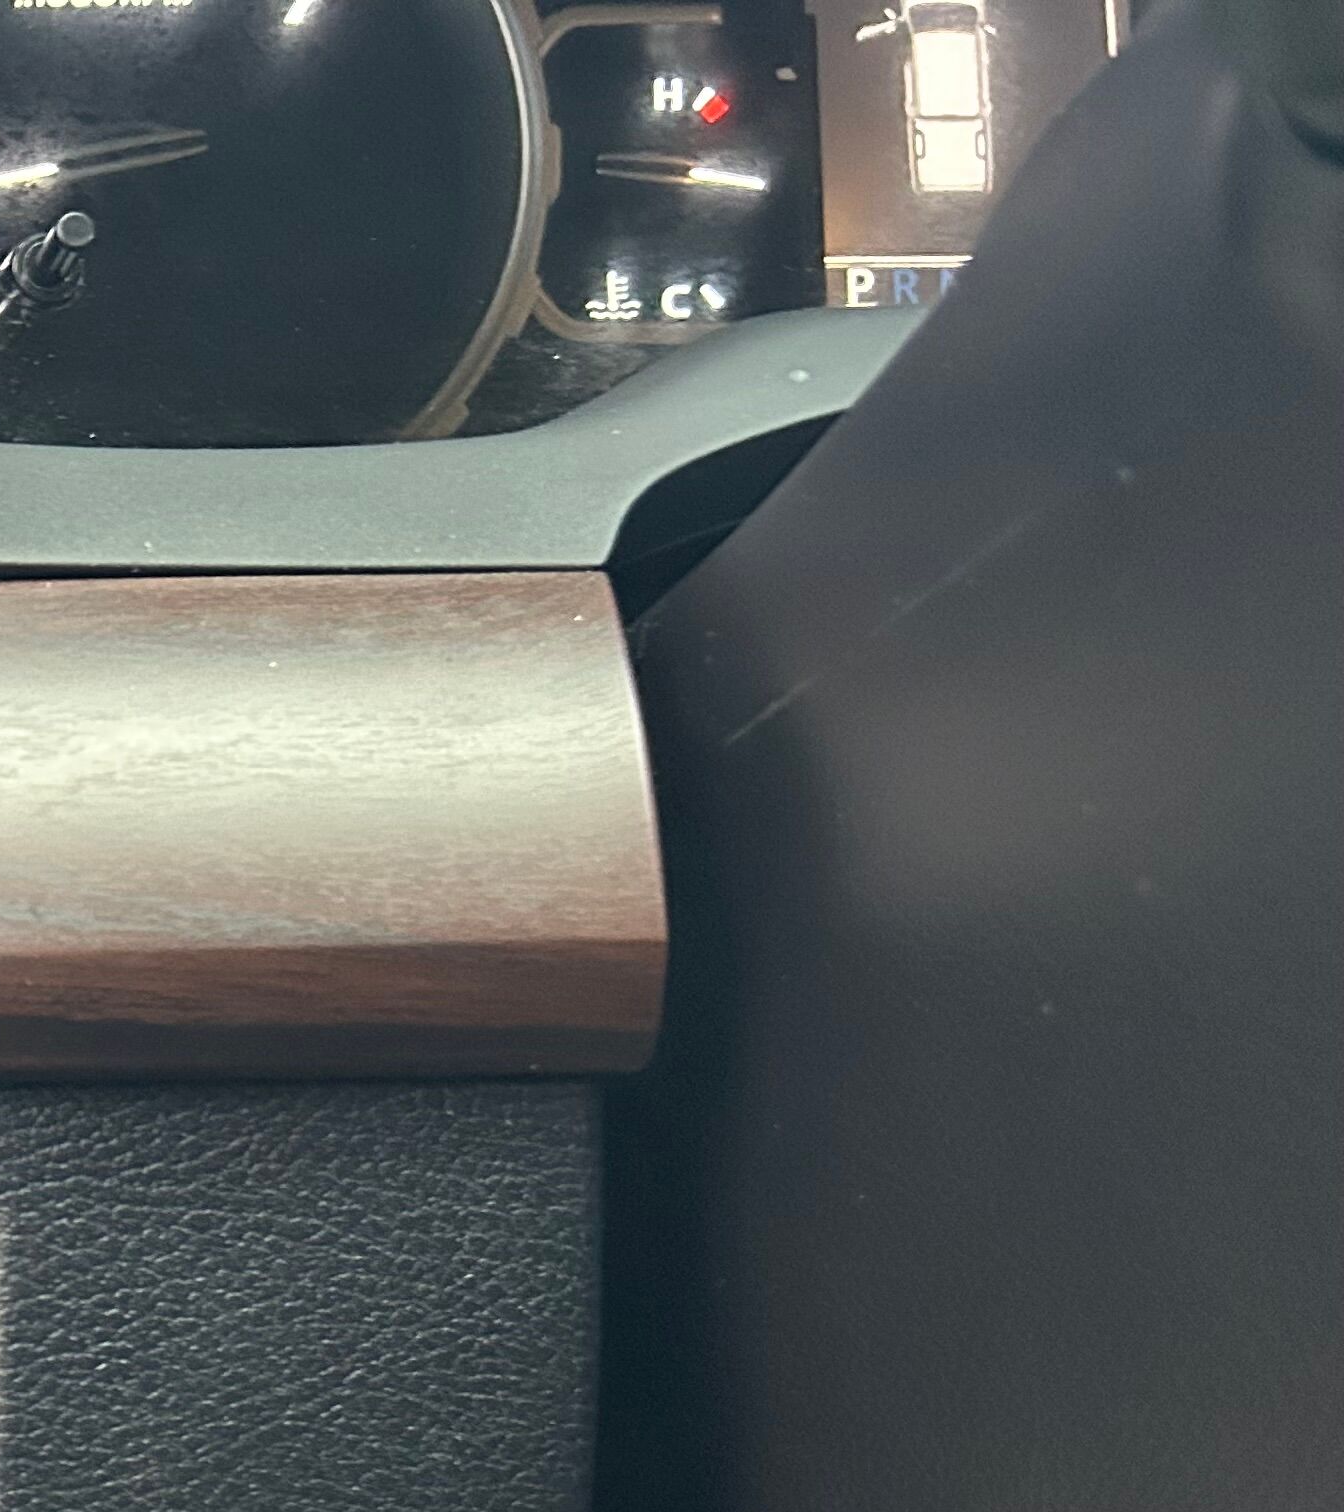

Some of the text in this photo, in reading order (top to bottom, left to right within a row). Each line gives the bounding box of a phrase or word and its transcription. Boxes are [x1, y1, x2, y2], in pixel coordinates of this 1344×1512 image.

[652, 77, 684, 113] H
[660, 283, 693, 320] C
[845, 267, 877, 307] P
[893, 268, 921, 305] R
